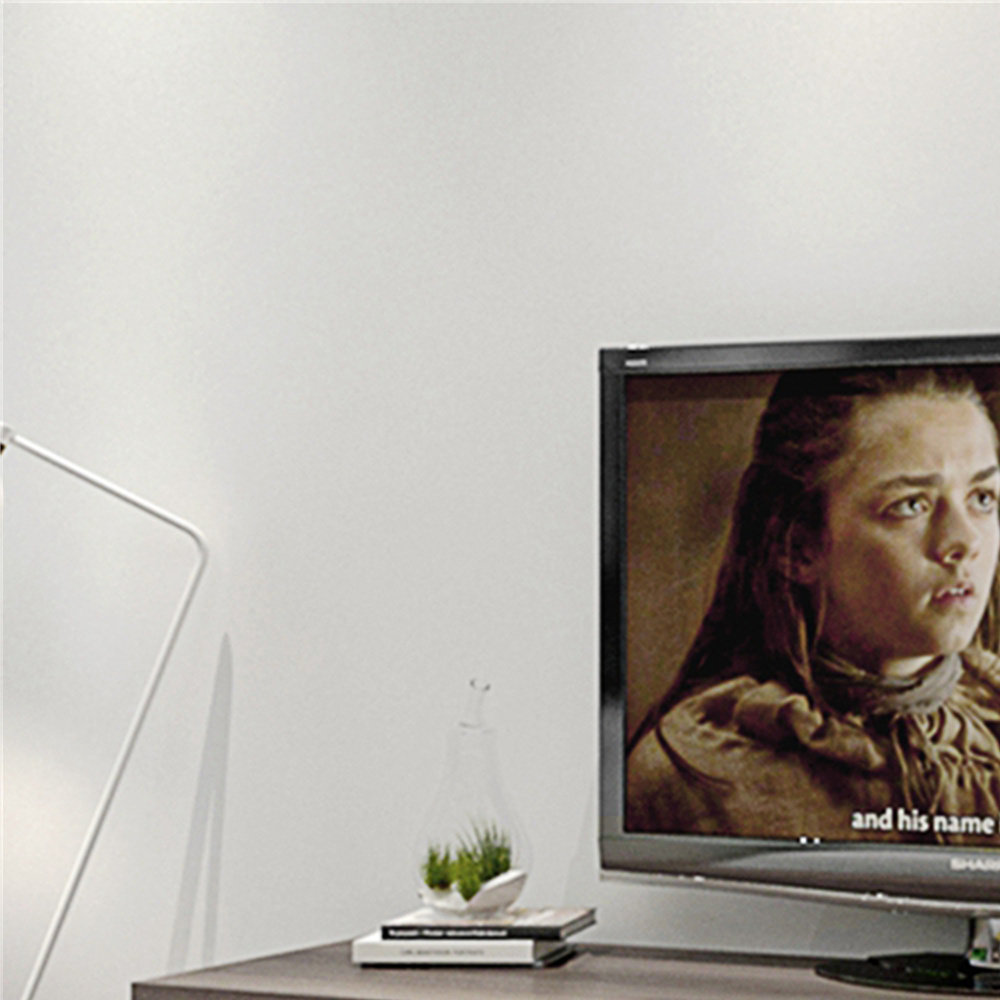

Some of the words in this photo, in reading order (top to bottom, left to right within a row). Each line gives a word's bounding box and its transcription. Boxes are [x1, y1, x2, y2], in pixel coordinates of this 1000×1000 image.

[851, 808, 893, 830] and
[898, 808, 929, 832] his
[934, 814, 994, 834] name
